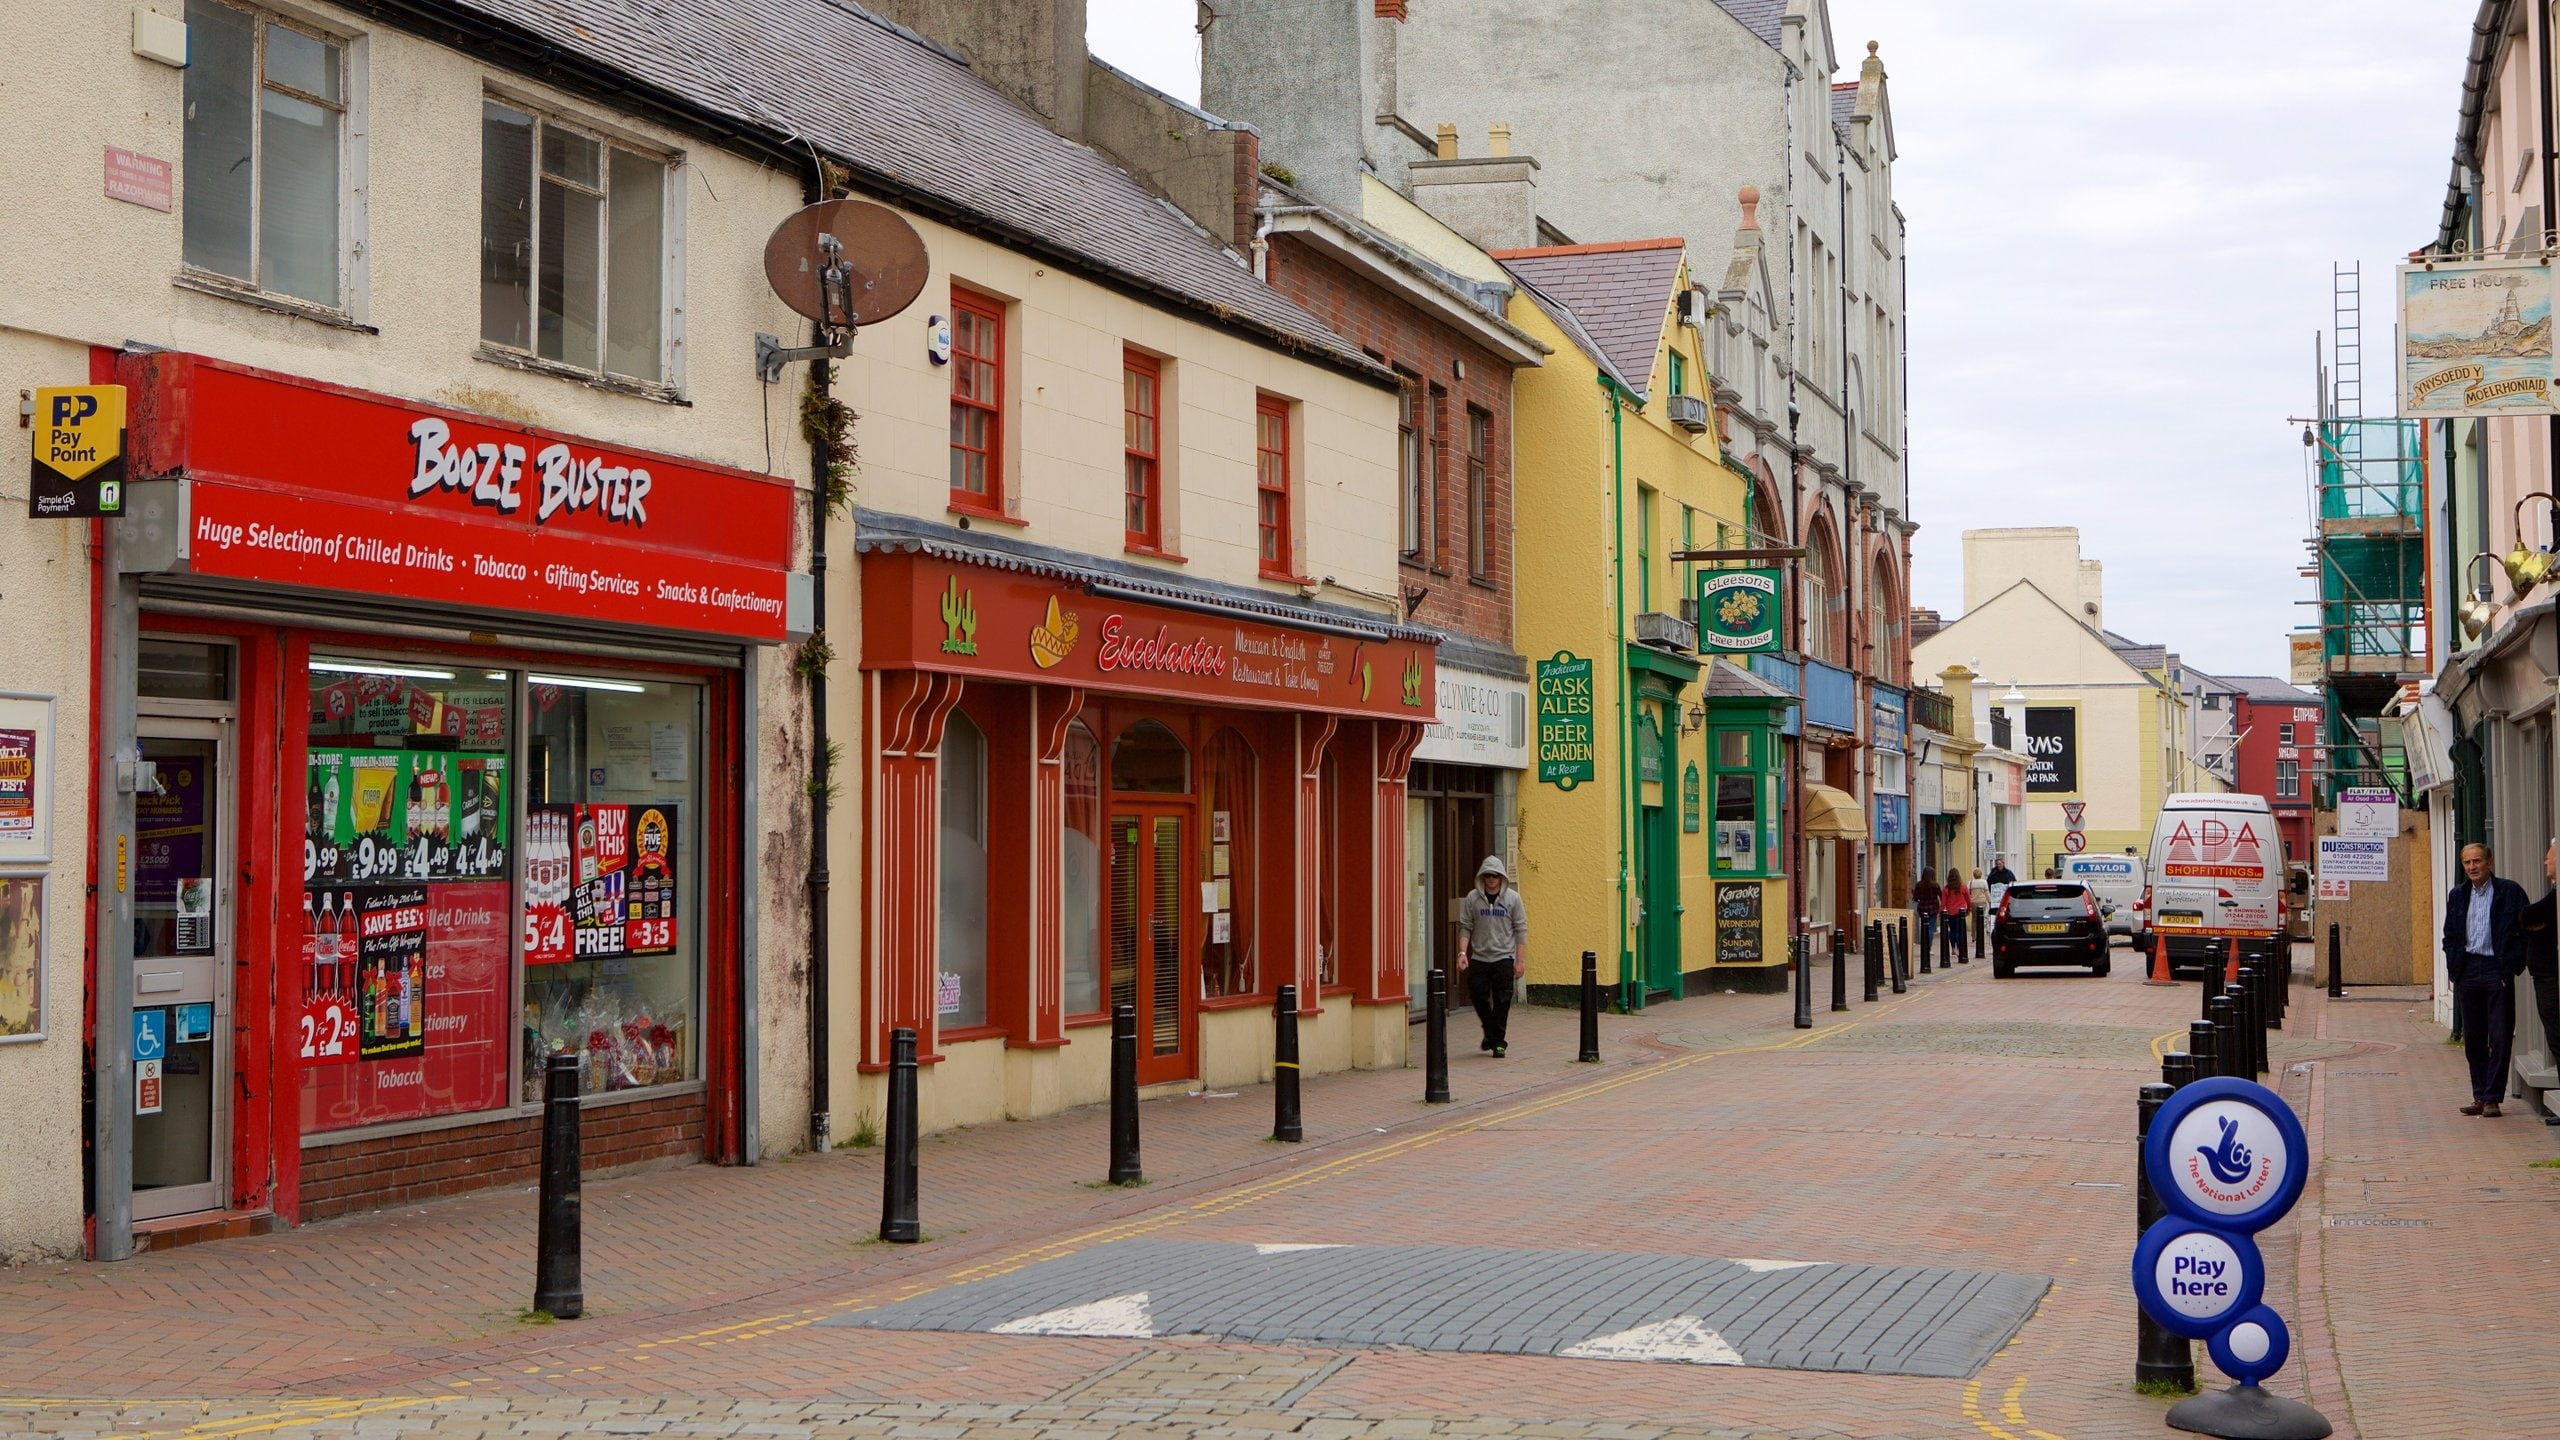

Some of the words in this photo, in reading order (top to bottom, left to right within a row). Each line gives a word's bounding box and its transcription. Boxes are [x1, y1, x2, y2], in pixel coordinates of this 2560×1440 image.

[116, 153, 163, 176] WARNING
[2430, 278, 2466, 290] FREE
[2416, 367, 2471, 394] YNYSOEDD
[2473, 366, 2482, 377] Y
[2466, 378, 2546, 404] MOELRHONIAID
[51, 430, 81, 448] Pay
[51, 446, 96, 461] Point
[409, 417, 526, 515] BOOZE
[536, 444, 651, 529] BUSTER
[38, 504, 69, 513] Payment
[197, 516, 242, 549] Huge
[247, 522, 329, 555] Selection
[325, 533, 343, 563] of
[346, 536, 401, 565] Chilled
[405, 545, 453, 572] Drinks
[473, 553, 526, 581] Tobacco
[545, 564, 587, 594] Gifting
[590, 570, 639, 596] Services
[657, 579, 696, 603] Snacks
[700, 588, 708, 604] &
[710, 587, 783, 618] Confectionery
[1235, 627, 1269, 656] Mexican
[1272, 640, 1277, 656] &
[1280, 634, 1306, 665] English
[1232, 657, 1272, 686] Restaurant
[1275, 671, 1280, 686] &
[1283, 663, 1298, 688] Take
[1300, 666, 1319, 698] Away
[1540, 661, 1586, 678] Traditional
[1540, 678, 1589, 695] CASK
[1440, 681, 1476, 713] GLYNNE
[1480, 688, 1485, 714] &
[1487, 690, 1501, 717] CO.
[1541, 697, 1590, 714] ALES
[368, 708, 380, 717] sell
[2294, 707, 2318, 722] EMPIRE
[369, 720, 399, 730] products
[1543, 725, 1587, 742] BEER
[1540, 743, 1592, 761] GARDEN
[350, 756, 368, 767] MORE
[1546, 765, 1556, 776] At
[1559, 764, 1580, 774] Rear
[420, 773, 438, 784] NEW!
[2040, 773, 2059, 783] PARK
[599, 809, 625, 835] BUY
[599, 836, 625, 855] THIS
[644, 833, 661, 846] FIVE
[2337, 842, 2384, 852] CONSTRUCTION
[304, 839, 338, 881] 9.99
[352, 837, 397, 879] £9.99
[405, 836, 449, 881] £4.49
[456, 844, 467, 874] 4
[470, 836, 502, 875] £4.49
[2167, 866, 2254, 877] SHOPFITTINGS
[575, 884, 589, 898] GET
[1718, 886, 1760, 904] Karaoke
[577, 895, 591, 910] ALL
[426, 908, 451, 927] illed
[454, 908, 491, 926] Drinks
[577, 907, 593, 921] THIS
[365, 913, 392, 935] SAVE
[525, 914, 539, 950] 5
[540, 916, 551, 931] For
[543, 914, 565, 951] £4
[1719, 919, 1760, 928] WEDNESDAY
[575, 927, 625, 955] FREE!
[642, 922, 651, 945] 3
[654, 921, 669, 944] £5
[1722, 939, 1754, 947] SUNDAY
[301, 1015, 315, 1057] 2
[316, 1021, 328, 1036] For
[320, 1005, 356, 1056] £2.50
[378, 1070, 423, 1089] Tobacco
[2188, 1155, 2199, 1178] The
[2196, 1179, 2246, 1202] National
[2246, 1157, 2271, 1196] Lottery
[2175, 1257, 2226, 1279] Play
[2172, 1278, 2228, 1296] here
